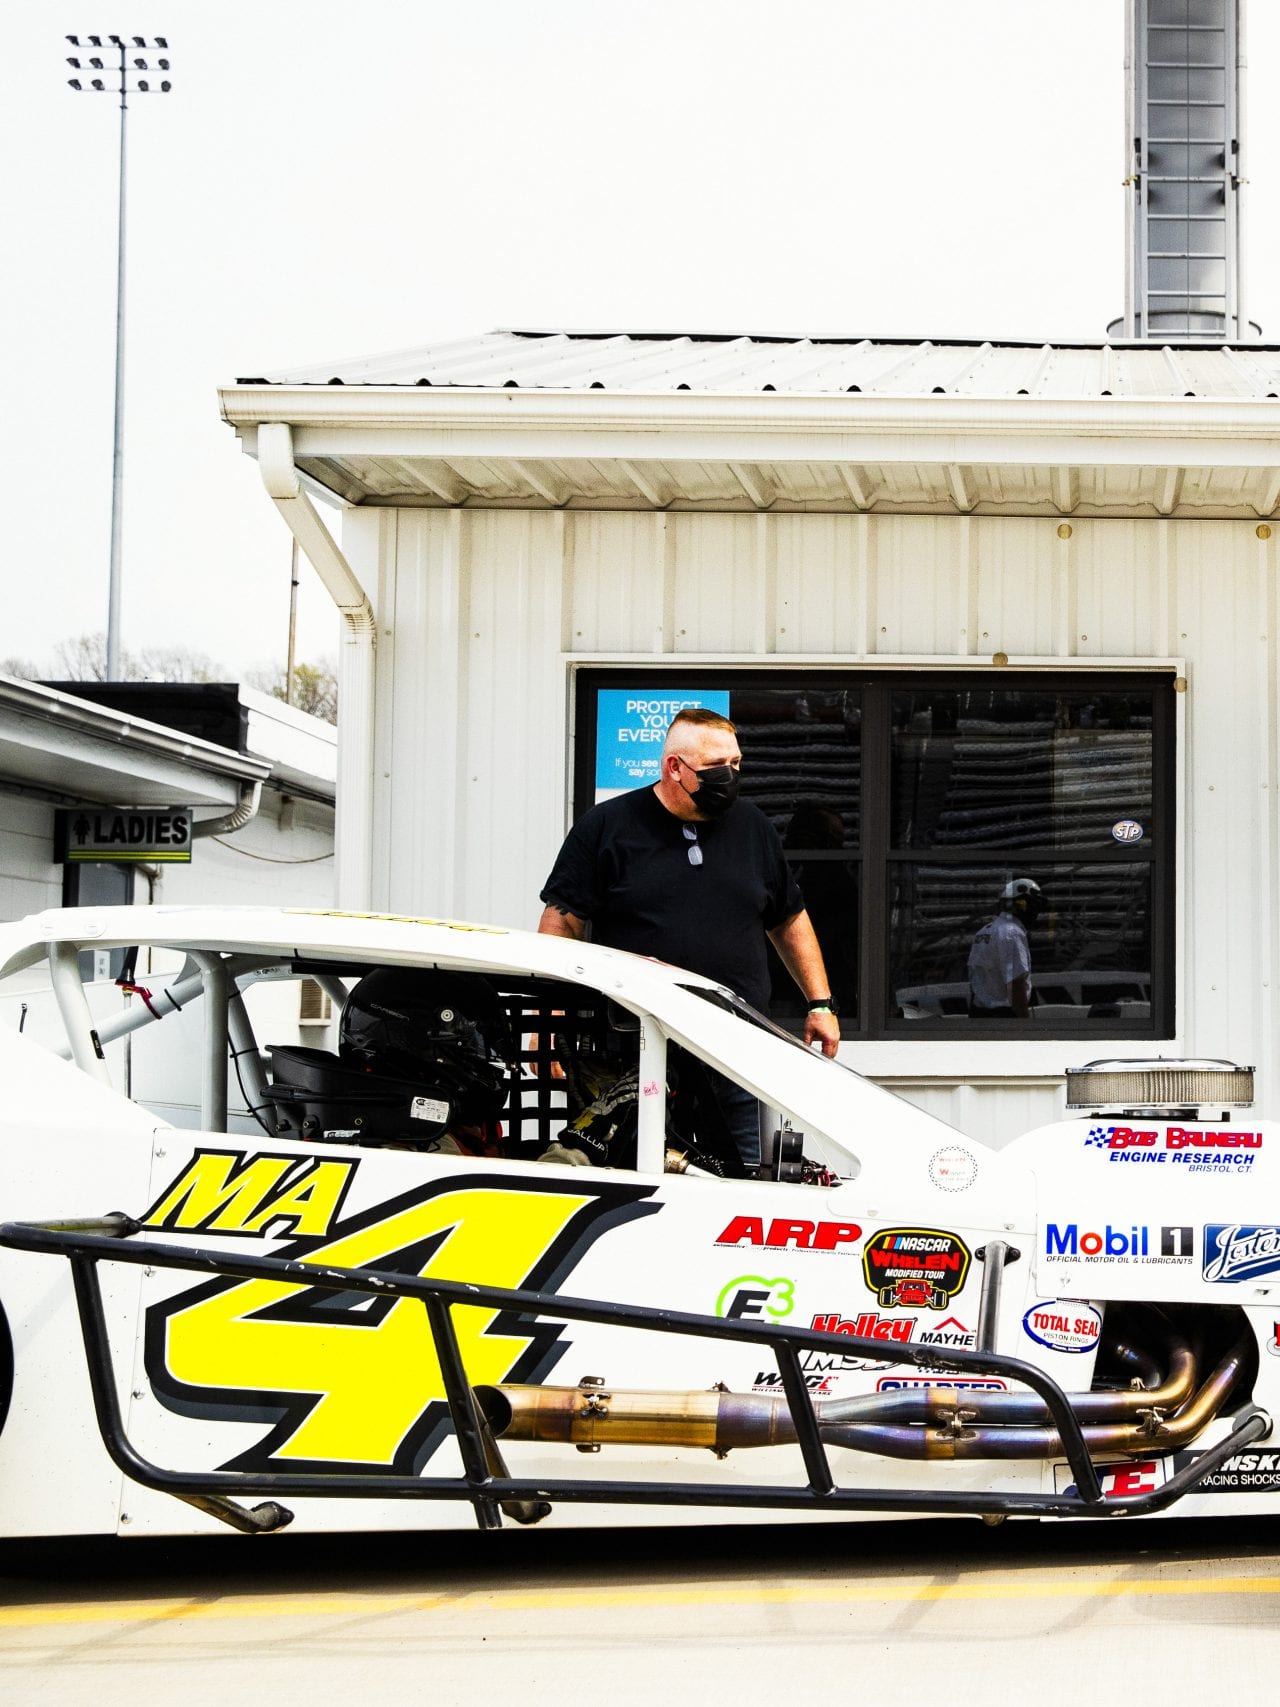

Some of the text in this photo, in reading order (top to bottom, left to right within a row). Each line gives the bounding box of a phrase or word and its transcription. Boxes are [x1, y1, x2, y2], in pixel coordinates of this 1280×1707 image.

[640, 715, 676, 728] YOU
[615, 758, 622, 767] If
[623, 760, 641, 769] you
[628, 769, 646, 778] say
[94, 815, 188, 844] LADIES
[1115, 822, 1141, 840] STP
[1110, 1152, 1255, 1165] ENGINE RESEARCH
[142, 1152, 354, 1237] MA
[715, 1216, 862, 1250] ARP
[1046, 1224, 1148, 1256] Mobil
[898, 1237, 951, 1252] NASCAR
[870, 1248, 960, 1271] WHELEN
[885, 1268, 945, 1280] MODIFIED TOUR
[161, 1186, 606, 1468] 4
[1033, 1313, 1099, 1337] TOTAL SEAL
[919, 1332, 975, 1346] MAYHE
[1043, 1332, 1069, 1341] PISTON
[1199, 1474, 1239, 1486] RACING
